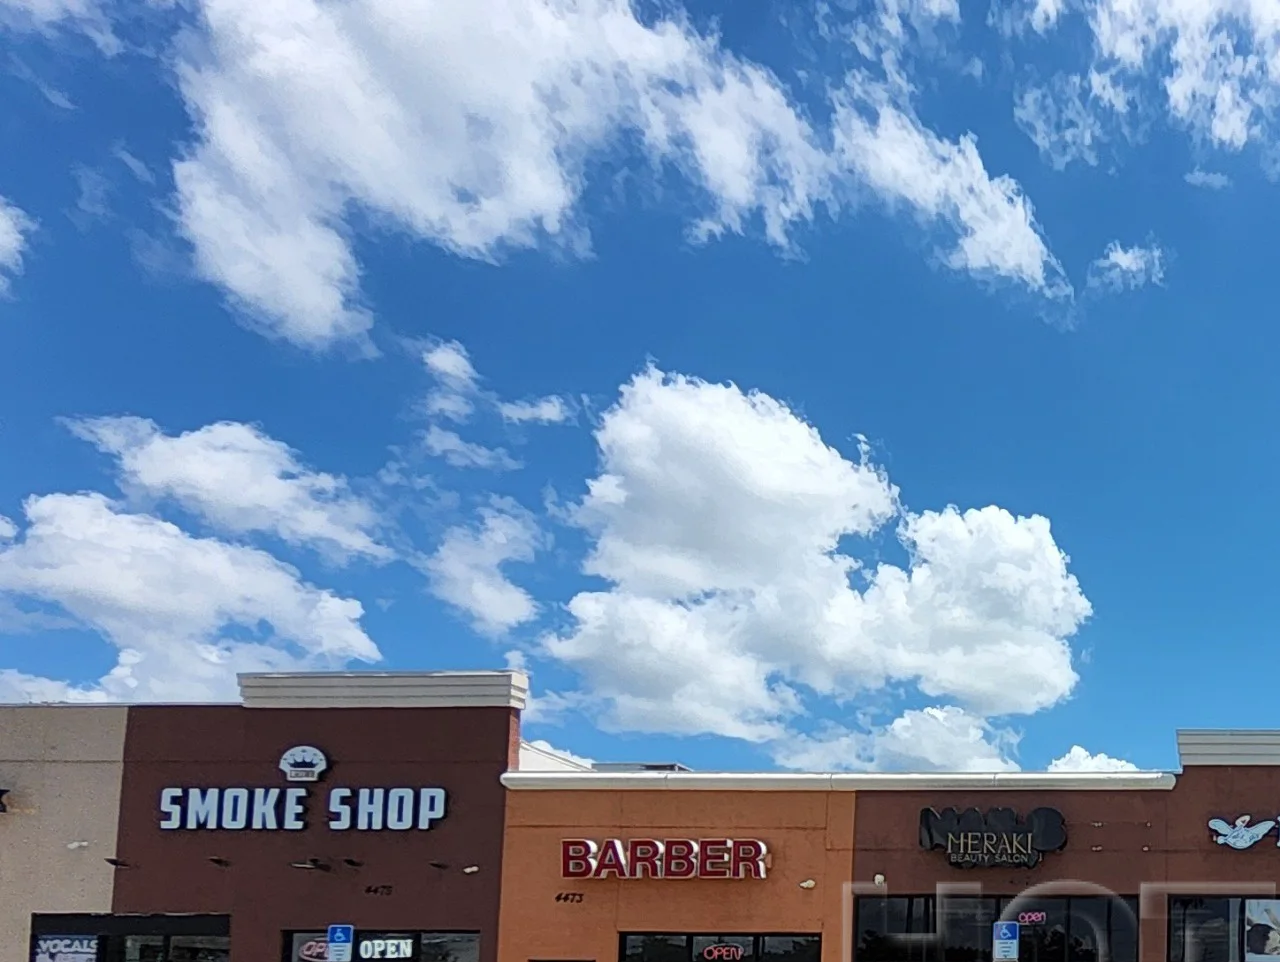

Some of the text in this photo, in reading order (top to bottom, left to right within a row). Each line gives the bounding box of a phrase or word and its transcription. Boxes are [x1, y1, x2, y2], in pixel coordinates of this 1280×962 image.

[160, 788, 447, 830] SMOKE SHOP
[946, 832, 1034, 854] MERAKI
[561, 838, 770, 880] BARBER
[950, 853, 1029, 863] BEAUTY SALON
[359, 939, 413, 959] OPEN
[703, 945, 744, 961] OPEN
